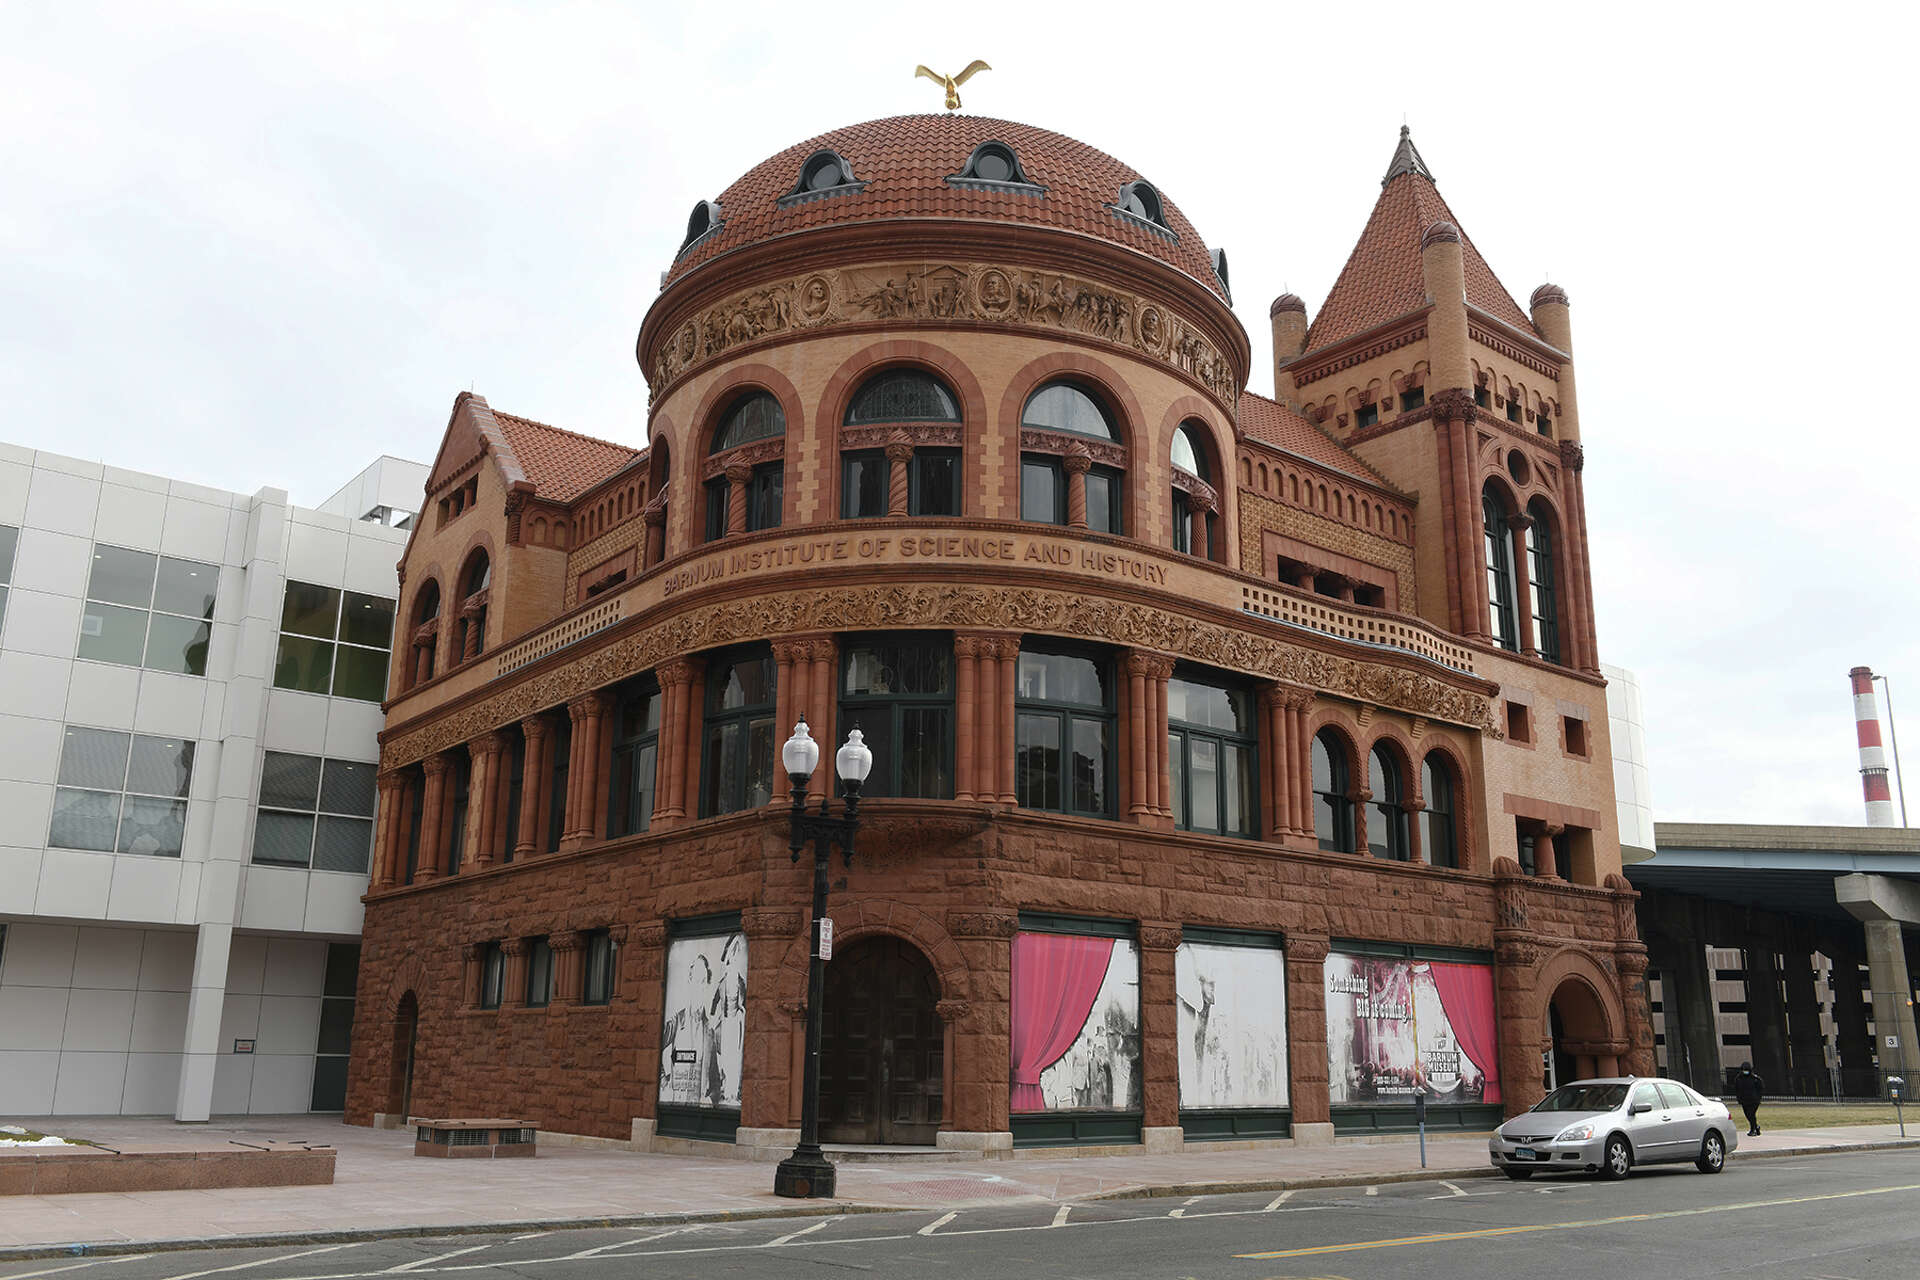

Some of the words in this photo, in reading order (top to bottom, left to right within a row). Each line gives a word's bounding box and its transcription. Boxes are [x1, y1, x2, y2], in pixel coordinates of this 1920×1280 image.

[663, 559, 724, 596] BARNUM
[730, 539, 848, 574] INSTITUTE
[858, 538, 891, 558] OF
[901, 536, 1016, 559] SCIENCE
[1024, 543, 1073, 566] AND
[1081, 549, 1168, 586] HISTORY
[1329, 974, 1369, 997] Something
[1356, 998, 1370, 1018] BIG
[1427, 1053, 1457, 1062] BARNUM
[1427, 1062, 1458, 1072] MUSEUM
